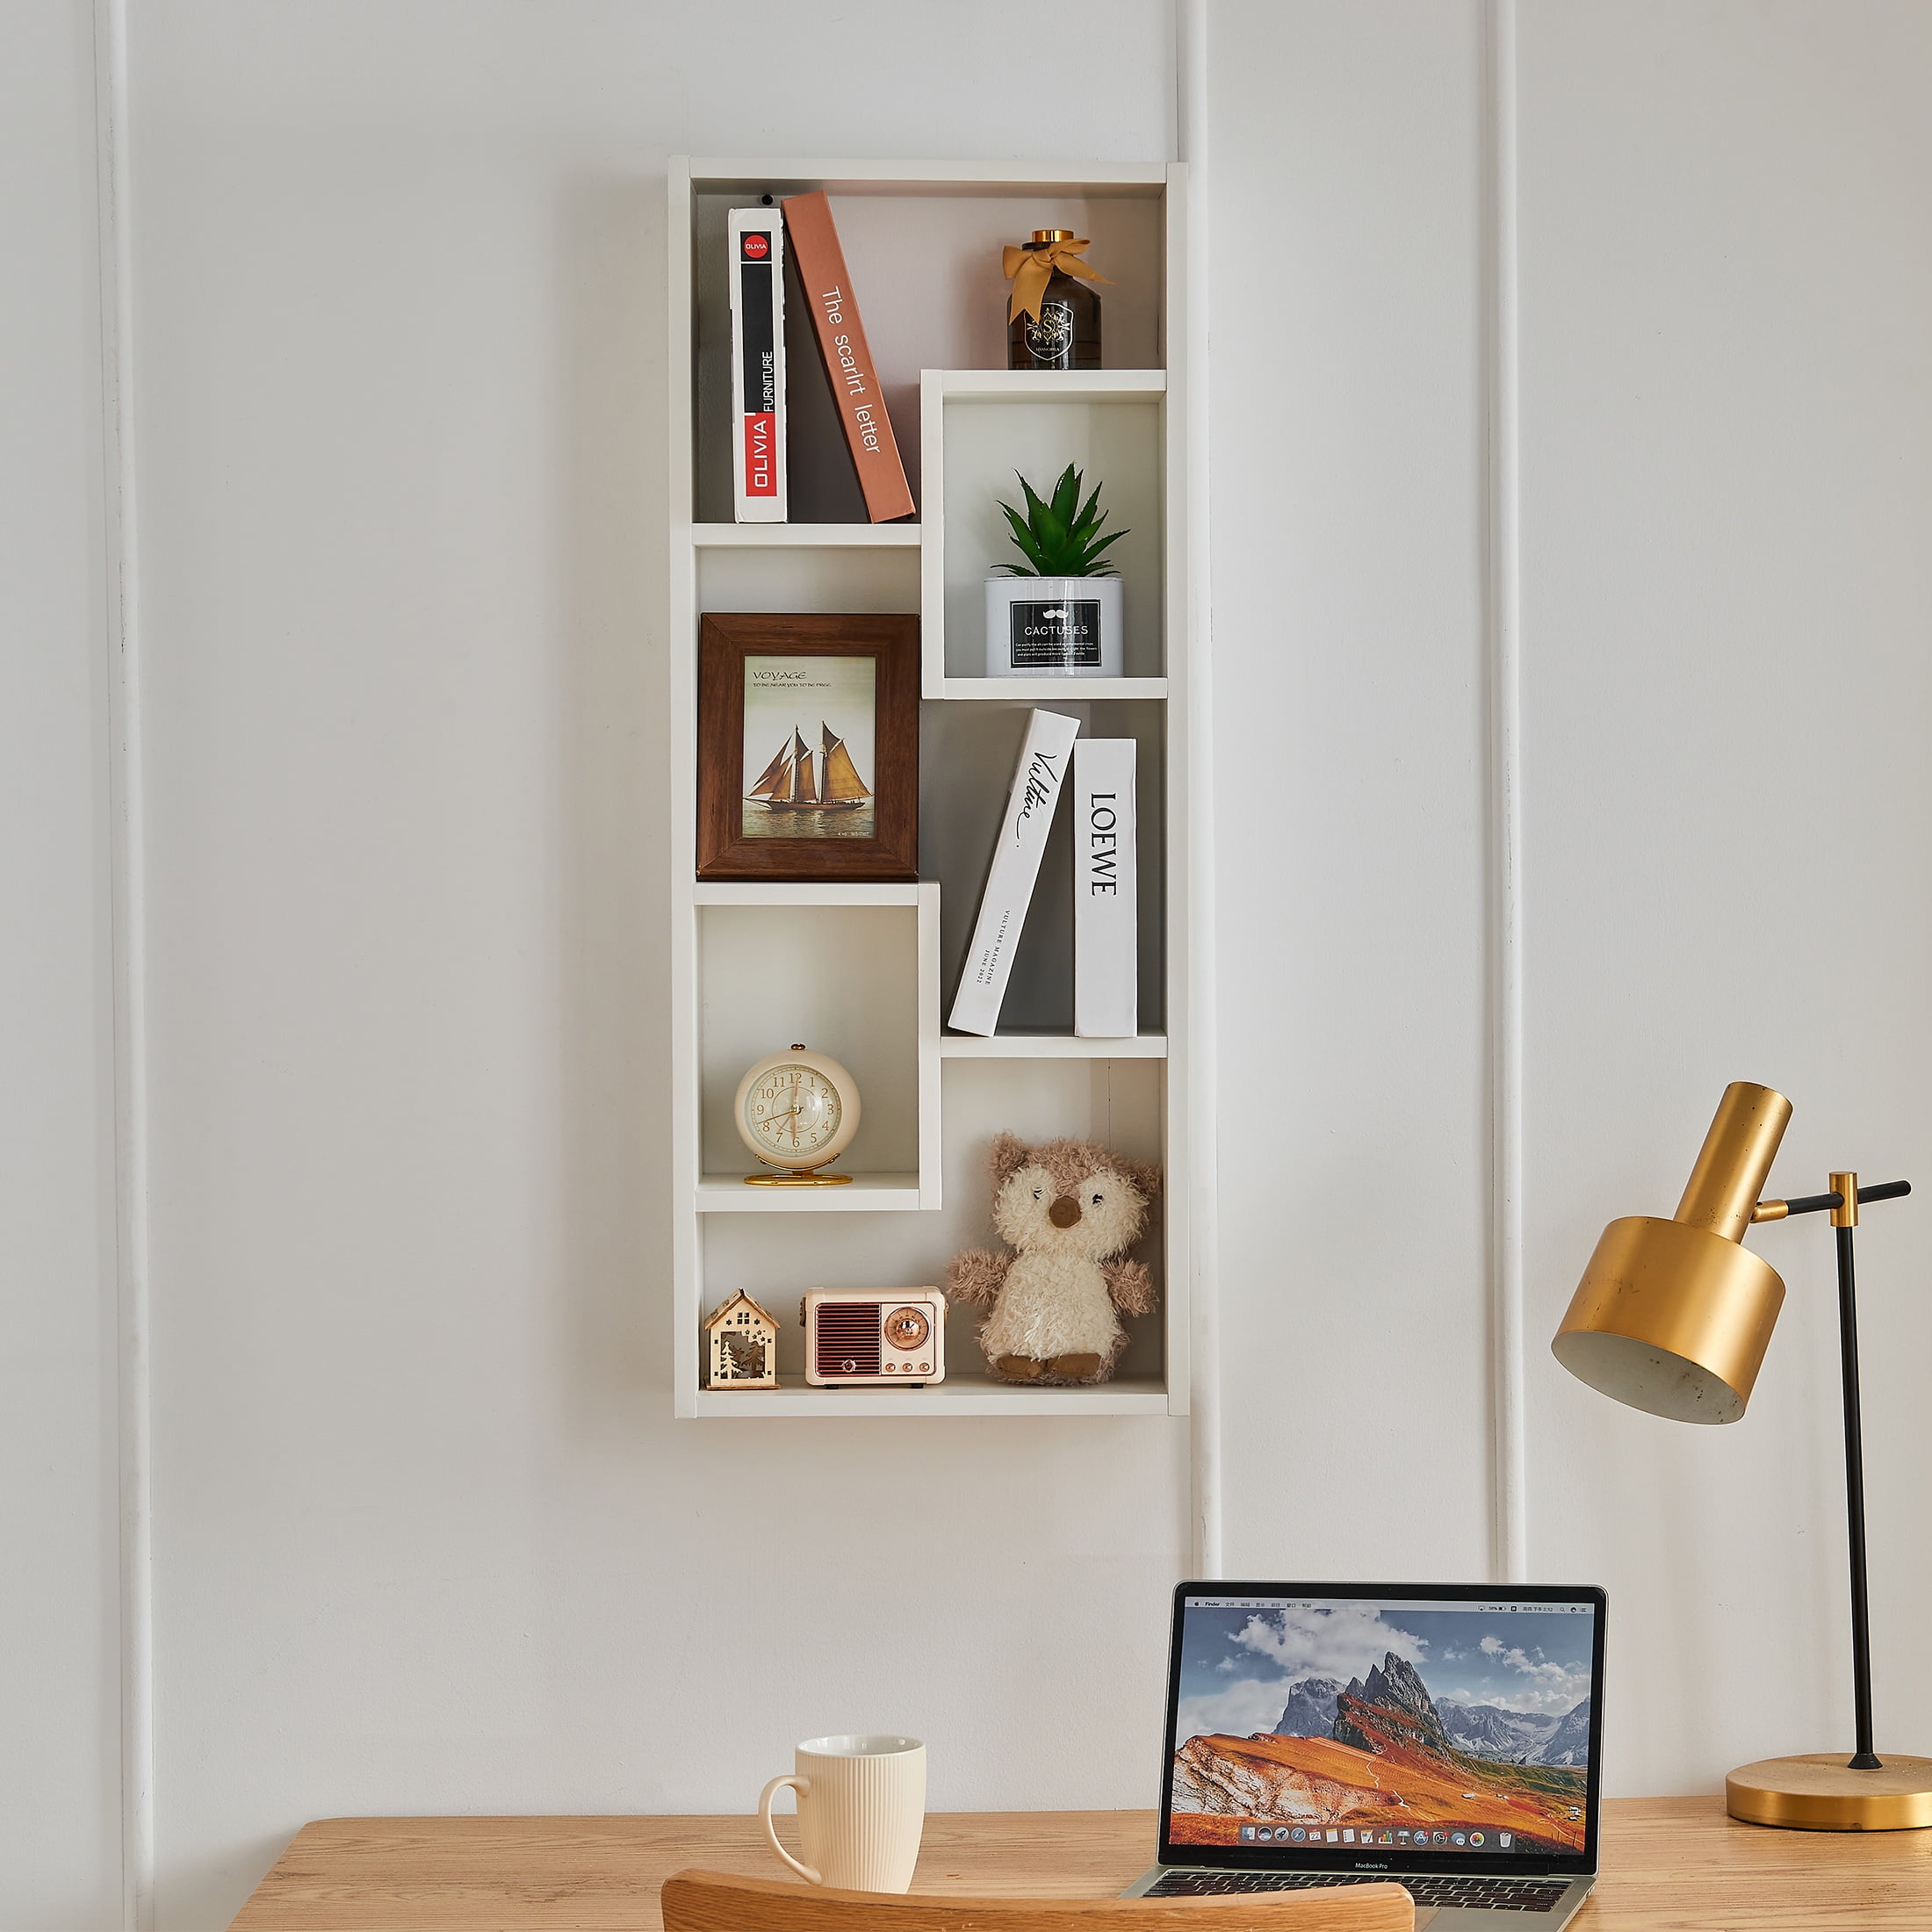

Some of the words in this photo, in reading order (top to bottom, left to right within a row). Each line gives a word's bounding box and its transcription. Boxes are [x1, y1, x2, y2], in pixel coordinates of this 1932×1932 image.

[821, 285, 843, 325] The
[833, 334, 866, 396] scarlrt
[854, 403, 880, 454] letter
[763, 351, 773, 412] FURNITURE
[753, 419, 768, 488] OLIVIA
[1025, 626, 1089, 636] CACTUSES
[753, 671, 807, 681] VOYAGE
[1091, 792, 1118, 897] LOEWE
[997, 910, 1011, 944] VULTURE
[981, 949, 991, 966] JUNE
[984, 946, 1000, 985] MAGAZINE
[977, 969, 985, 984] 2022
[773, 1077, 785, 1087] 11
[789, 1073, 802, 1084] 12
[810, 1077, 816, 1087] 1
[761, 1088, 774, 1099] 10
[821, 1088, 828, 1099] 2
[757, 1105, 764, 1115] 9
[827, 1104, 834, 1115] 3
[762, 1121, 770, 1132] 8
[822, 1121, 829, 1131] 4
[776, 1132, 783, 1143] 7
[792, 1136, 800, 1148] 6
[811, 1133, 817, 1143] 5
